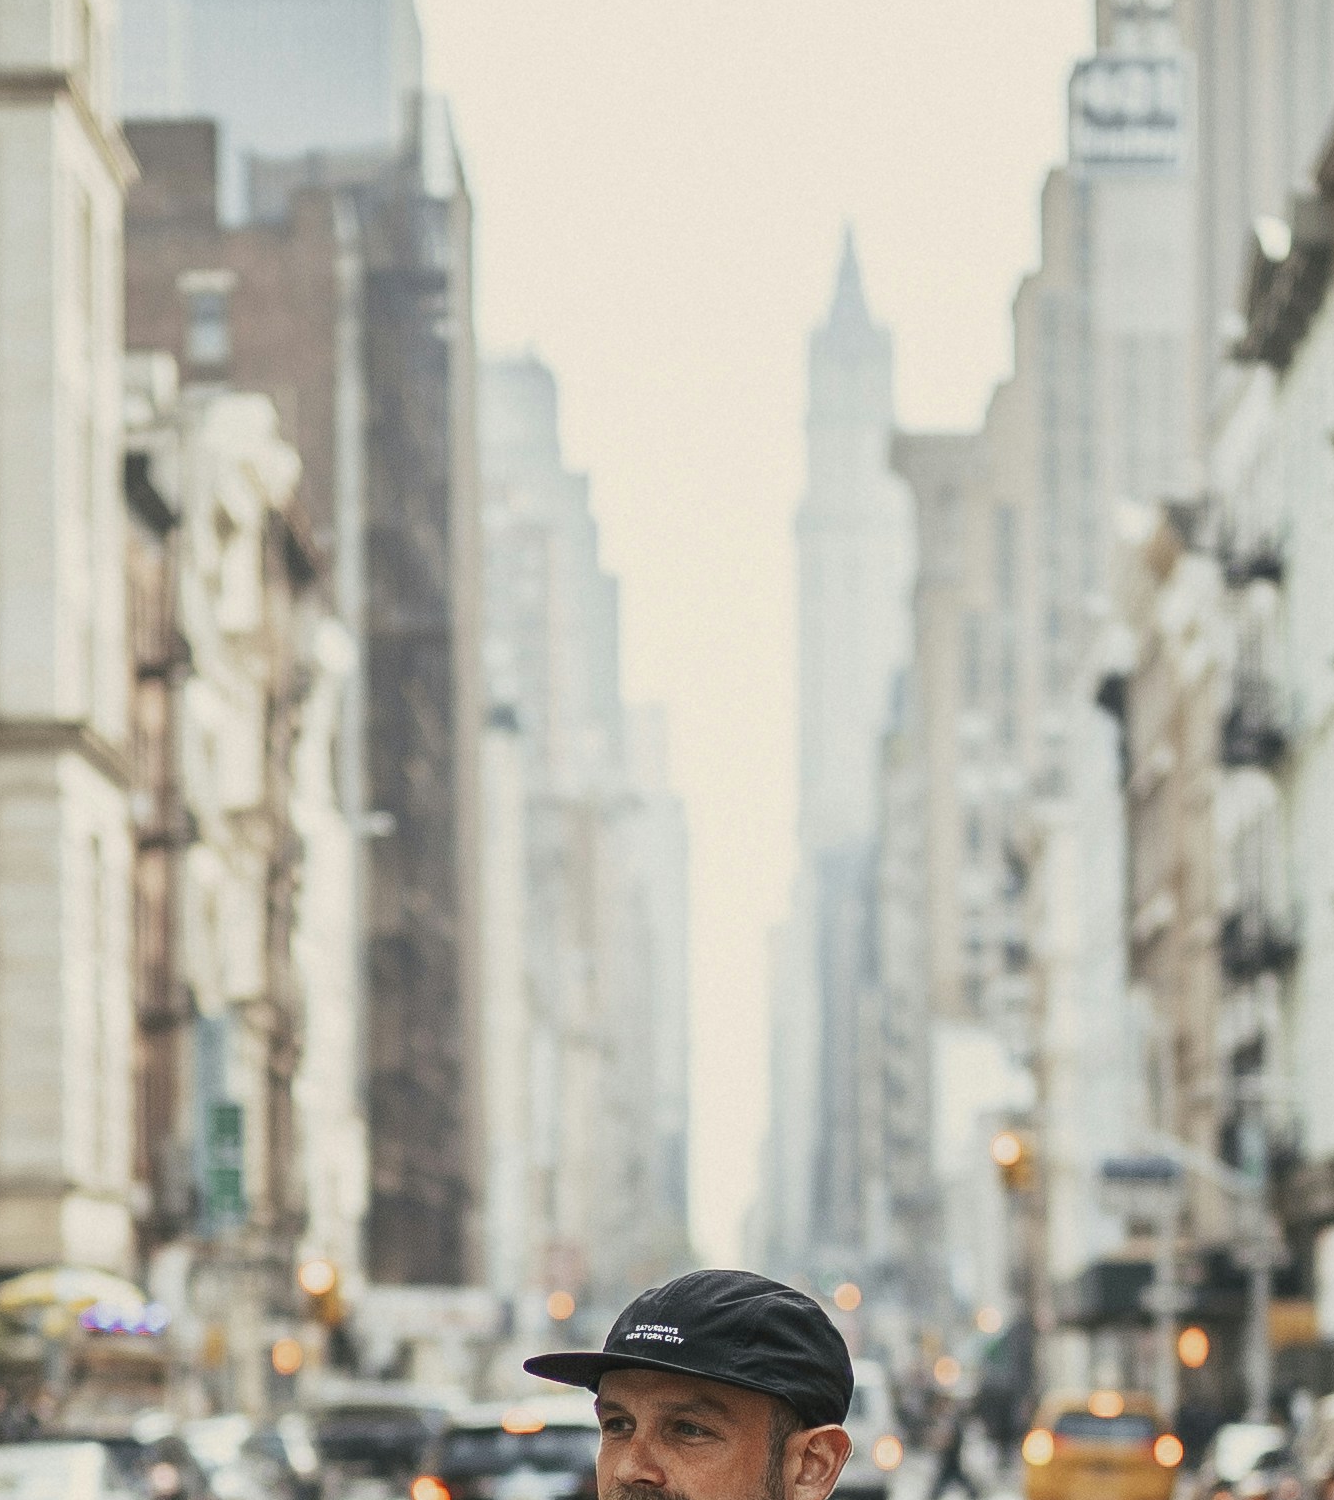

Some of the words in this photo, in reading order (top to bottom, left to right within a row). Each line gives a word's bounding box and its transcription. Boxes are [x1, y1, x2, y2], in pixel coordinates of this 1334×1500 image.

[635, 1325, 679, 1334] SATURDAYS
[626, 1332, 642, 1341] NEW
[643, 1332, 664, 1341] YORK
[664, 1334, 685, 1345] CITY
